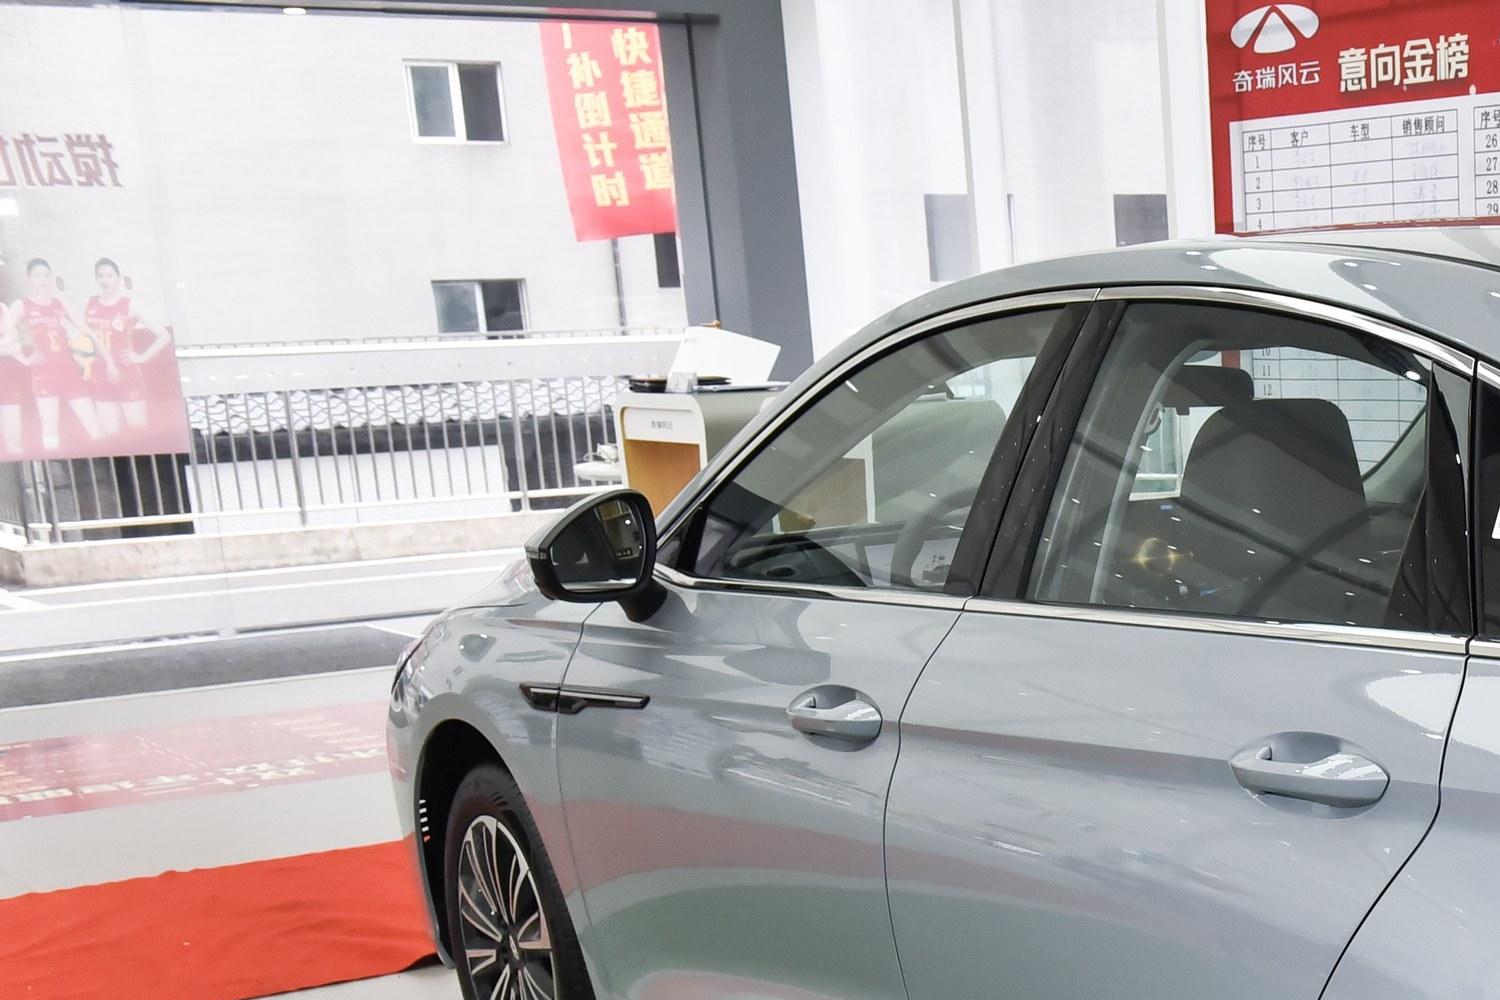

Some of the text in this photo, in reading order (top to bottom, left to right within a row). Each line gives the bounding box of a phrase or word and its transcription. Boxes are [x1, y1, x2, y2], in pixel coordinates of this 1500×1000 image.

[1338, 33, 1470, 92] 意向金榜
[1232, 60, 1321, 93] 奇瑞风云
[610, 26, 672, 191] 快捷通道
[1350, 123, 1371, 142] 车型
[1402, 115, 1446, 138] 销售顾问
[1485, 133, 1498, 149] 26
[1485, 156, 1498, 172] 27
[1486, 179, 1499, 195] 28
